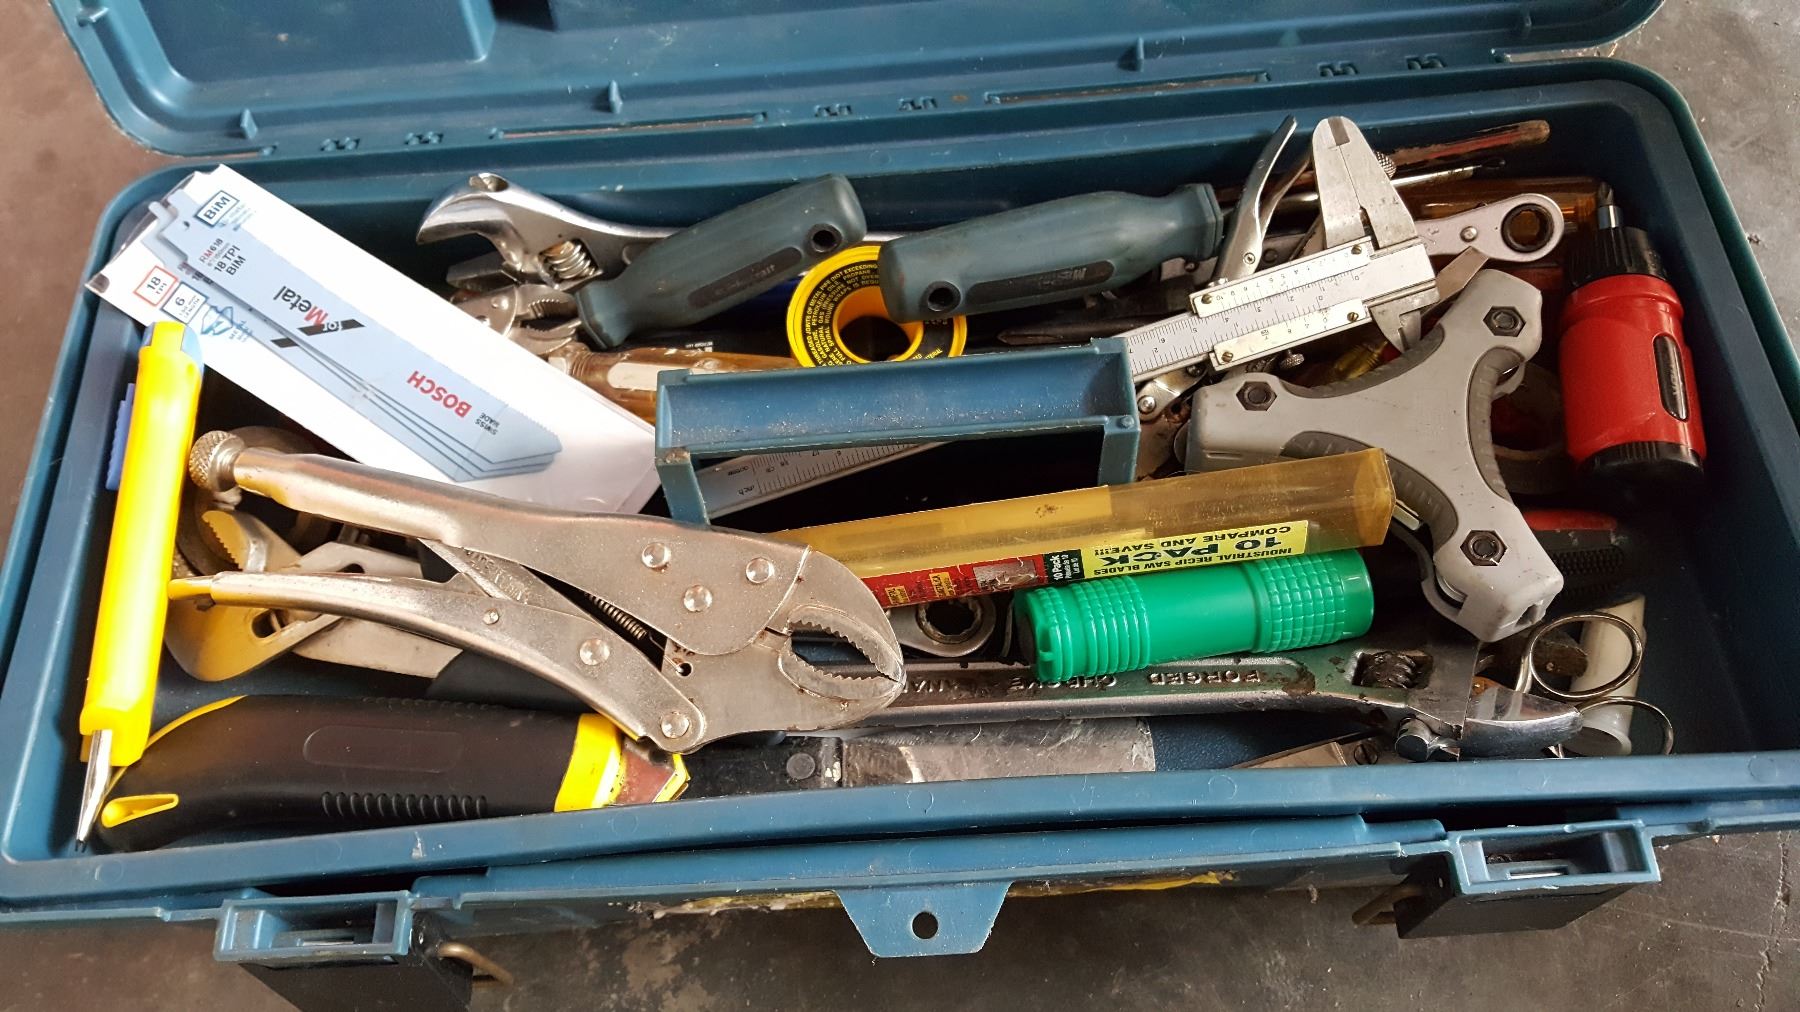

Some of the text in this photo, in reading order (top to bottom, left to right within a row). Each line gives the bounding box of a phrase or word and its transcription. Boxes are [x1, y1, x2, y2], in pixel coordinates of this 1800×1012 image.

[203, 196, 230, 220] BiM
[214, 244, 241, 273] 18 TPI
[226, 256, 246, 276] BIM
[147, 277, 161, 291] 18
[175, 297, 185, 306] 6
[273, 286, 343, 331] for Metal
[406, 370, 472, 418] BOSCH
[1161, 537, 1197, 549] AND
[1202, 525, 1291, 544] COMPARE
[1093, 547, 1292, 576] INDUSTRIAL RECIP SAW BLADES
[1101, 536, 1282, 567] 10 PACK
[1050, 554, 1064, 581] 10 Pack
[1150, 669, 1262, 686] FORGED
